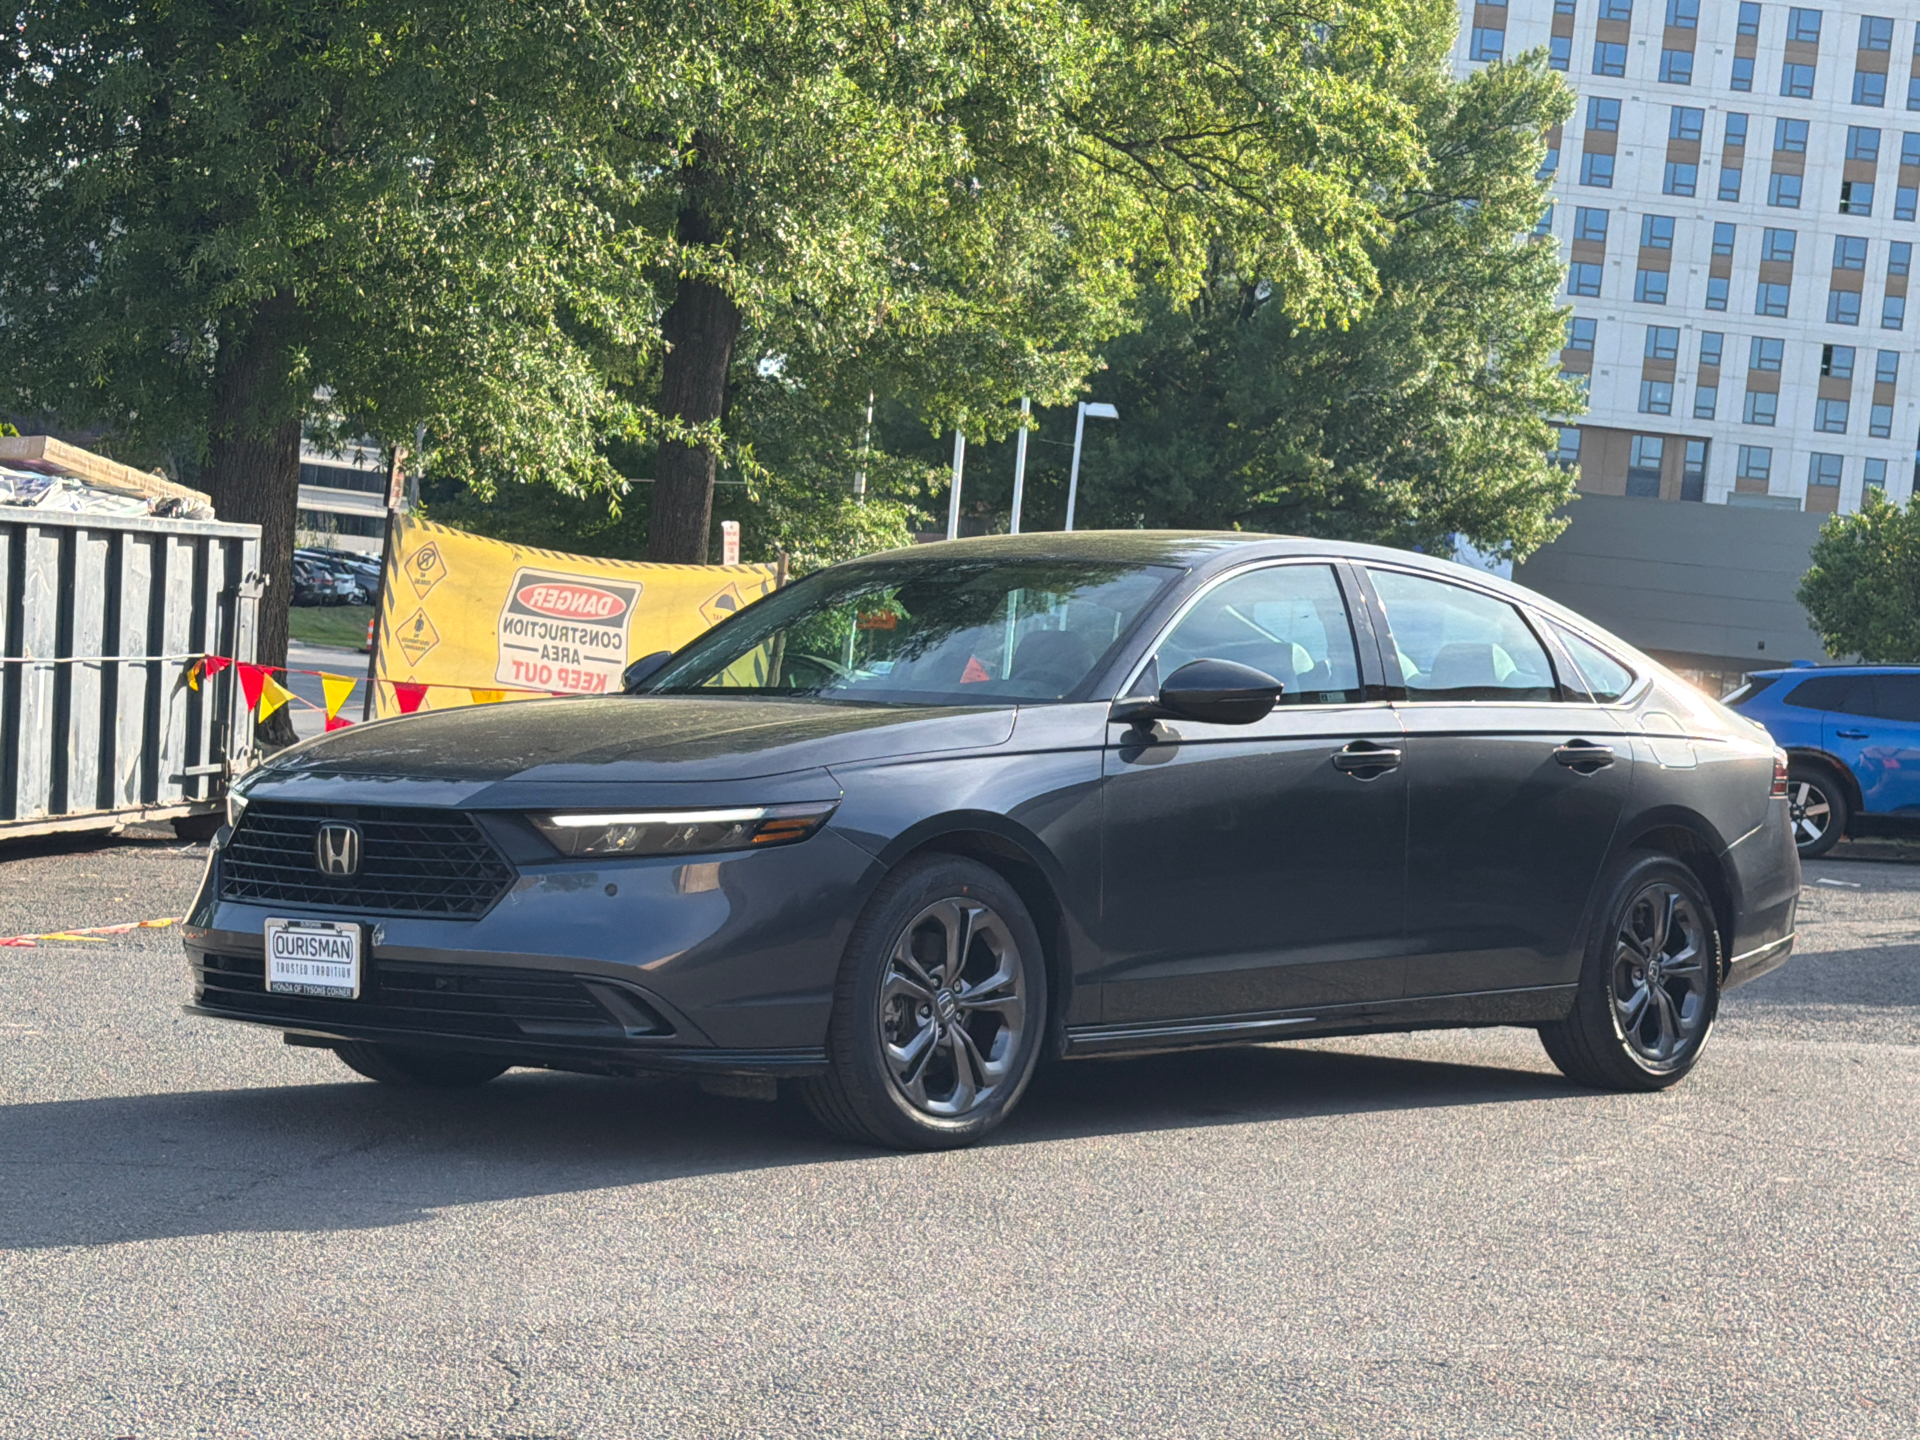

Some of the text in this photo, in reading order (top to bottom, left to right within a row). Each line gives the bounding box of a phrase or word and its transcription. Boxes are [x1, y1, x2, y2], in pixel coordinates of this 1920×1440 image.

[276, 935, 350, 959] OURISMAN
[276, 962, 351, 978] TRUSTED TRADITION
[272, 982, 293, 994] HONDA
[293, 984, 302, 994] OF
[326, 987, 351, 998] CORNER
